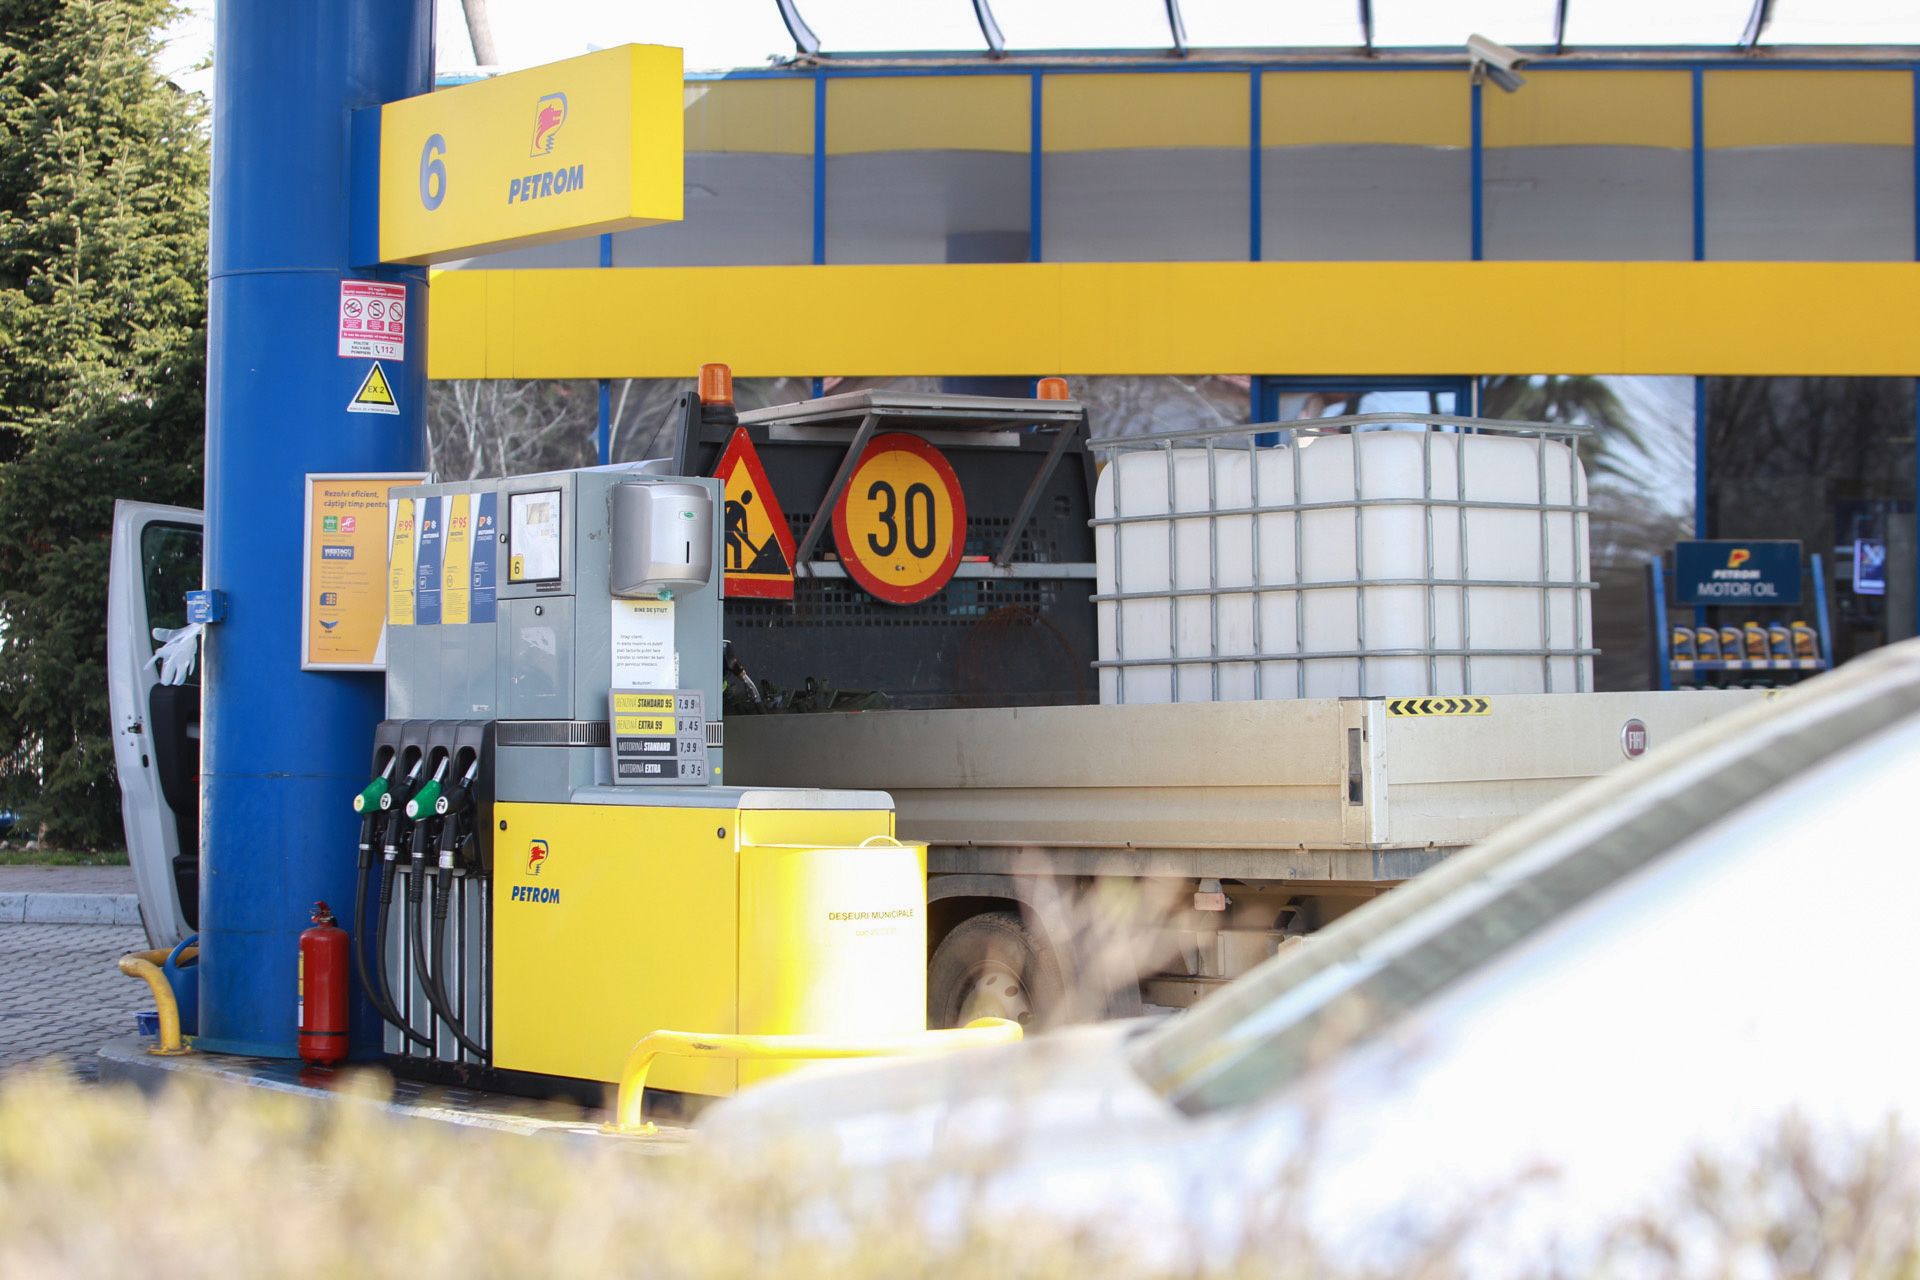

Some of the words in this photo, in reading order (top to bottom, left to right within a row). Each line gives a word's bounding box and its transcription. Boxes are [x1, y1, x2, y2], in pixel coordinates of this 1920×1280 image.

[420, 133, 447, 212] 6
[508, 164, 584, 205] PETROM
[380, 346, 394, 354] 112
[324, 489, 350, 498] Rezolvi
[351, 490, 380, 499] eficient,
[348, 500, 364, 509] timp
[867, 480, 936, 559] 30
[514, 561, 520, 575] 6
[1712, 570, 1762, 580] PETROM
[1697, 582, 1752, 596] MOTOR
[1753, 582, 1779, 597] OIL
[638, 698, 664, 708] STANDARD
[665, 698, 672, 708] 95
[638, 720, 654, 729] EXTRA
[655, 720, 663, 730] 99
[643, 742, 671, 751] STANDARD
[644, 764, 662, 774] EXTRA
[511, 886, 560, 904] PETROM
[871, 908, 913, 919] MUNICIPALE
